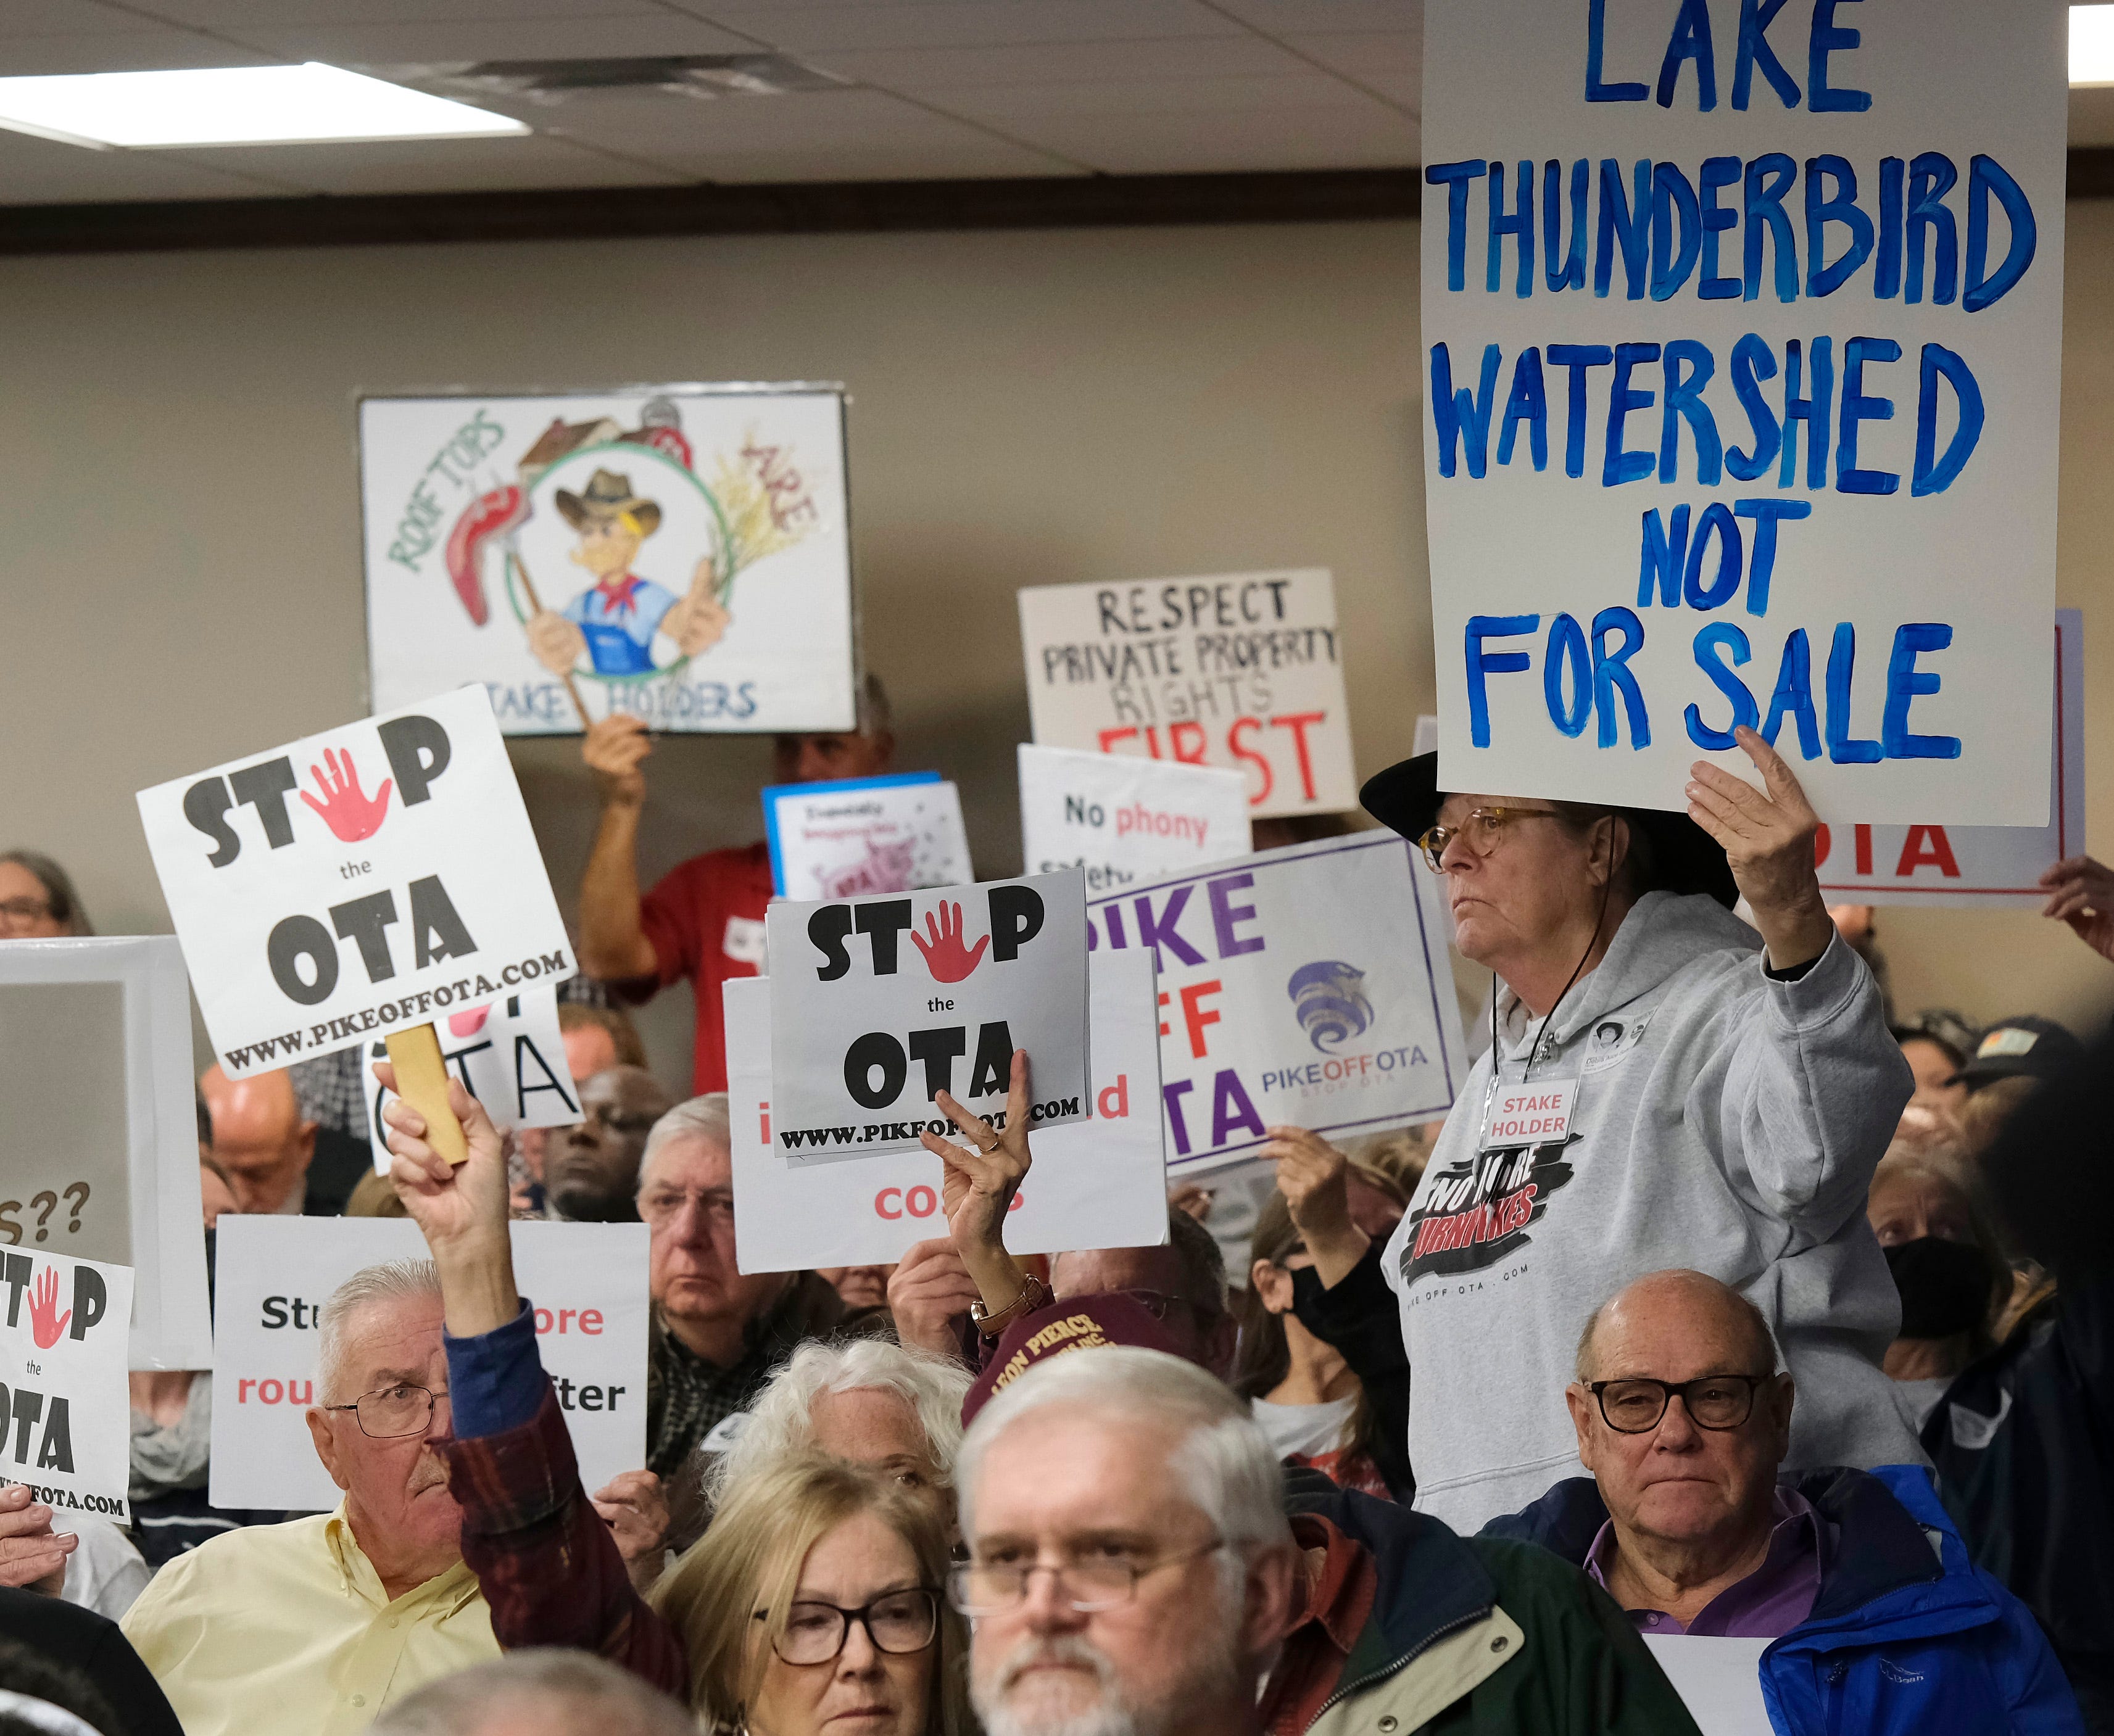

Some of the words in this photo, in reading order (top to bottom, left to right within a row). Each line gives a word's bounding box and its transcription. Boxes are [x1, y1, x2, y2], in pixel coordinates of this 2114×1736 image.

[1585, 0, 1872, 112] LAKE
[1425, 152, 2037, 313] THUNDERBIRD
[1431, 333, 1984, 497] WATERSHED
[742, 444, 819, 534] ARE
[1638, 498, 1812, 618] NOT
[1098, 580, 1290, 635] RESPECT
[1043, 638, 1182, 684] PRIVATE
[1195, 627, 1337, 673] PROPERTY
[1113, 672, 1275, 722] RIGHTS
[1465, 606, 1651, 751] FOR
[1685, 621, 1962, 766] SALE
[463, 682, 566, 721] TAKE
[608, 682, 758, 720] HOLDERS
[183, 714, 451, 869] STP
[1098, 711, 1326, 806] RST
[1064, 795, 1105, 829] No
[1116, 803, 1209, 848] phony
[339, 859, 373, 881] the
[267, 874, 479, 1006] OTA
[807, 885, 1045, 982] STP
[1087, 872, 1266, 974] IKE
[224, 949, 568, 1072] WWW.PIKEOFFOTA.COM
[927, 996, 955, 1013] the
[844, 1020, 1015, 1110] OTA
[1503, 1094, 1563, 1114] STAKE
[1163, 1068, 1267, 1156] TA
[1491, 1117, 1565, 1137] HOLDER
[1425, 1176, 1474, 1212] NO
[535, 1307, 604, 1335] ore
[27, 1359, 42, 1376] the
